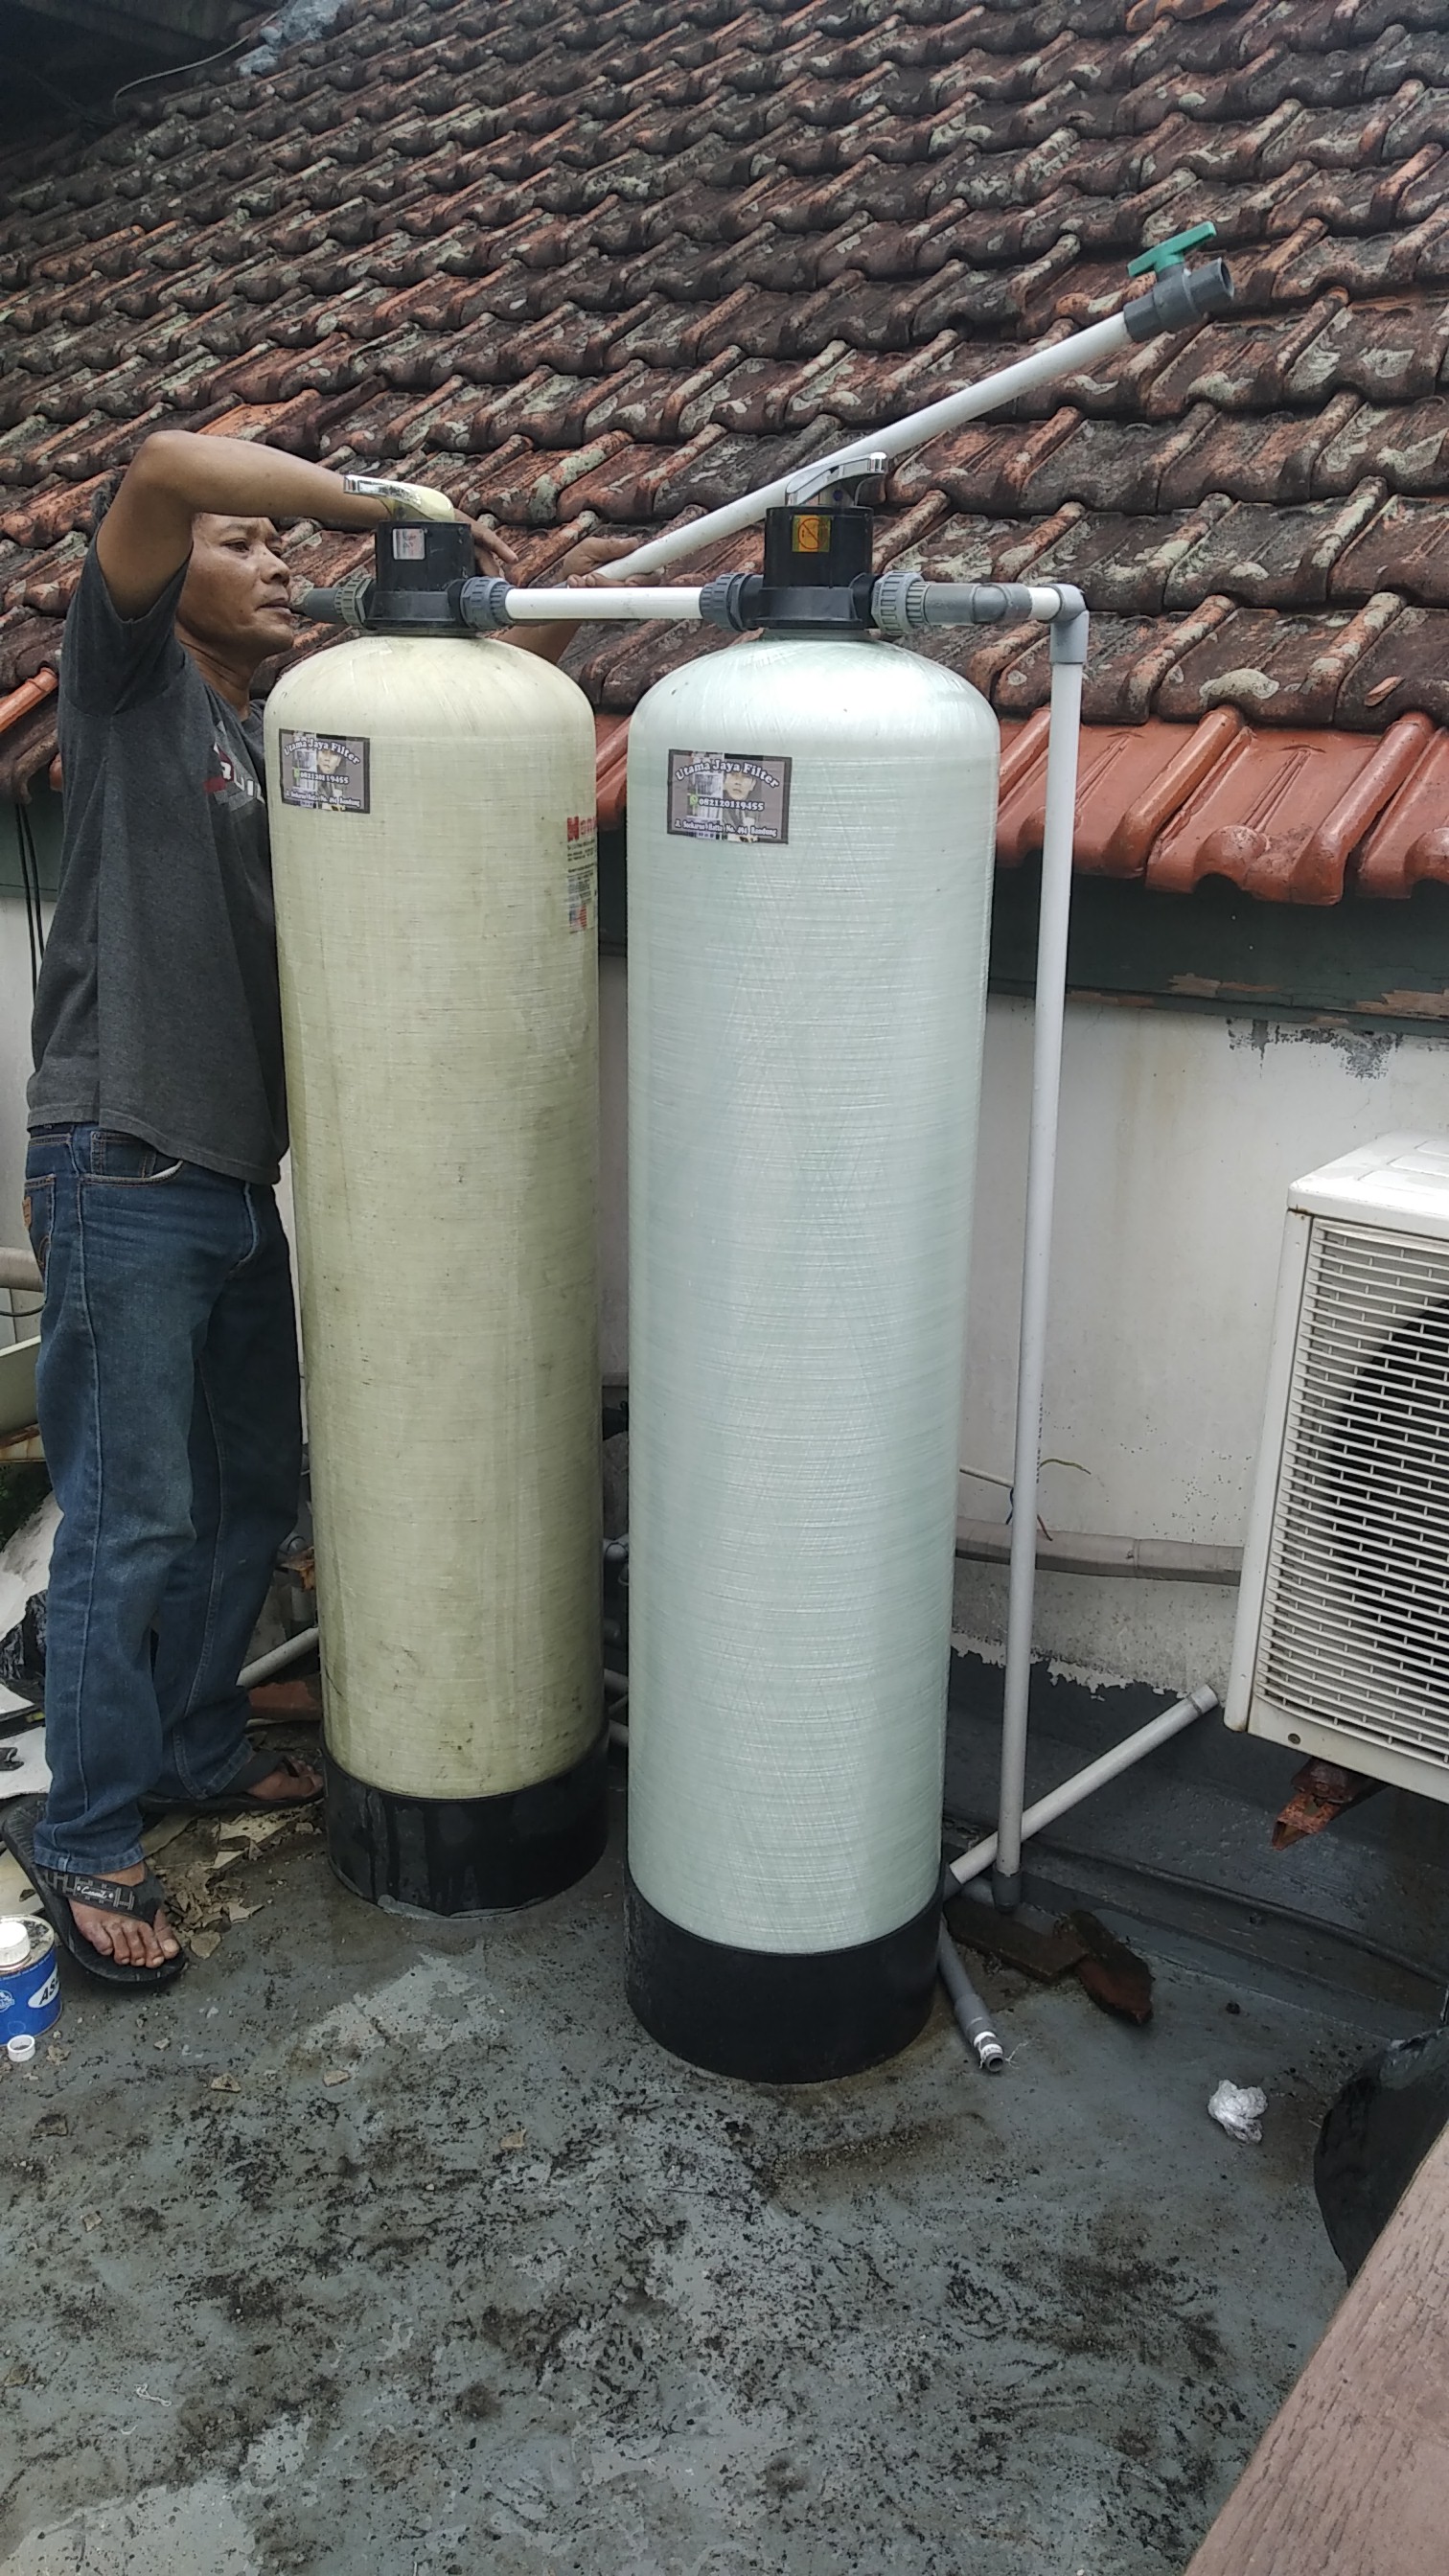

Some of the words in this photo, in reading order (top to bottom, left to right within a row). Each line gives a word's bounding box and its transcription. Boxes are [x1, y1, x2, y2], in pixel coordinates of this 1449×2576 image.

[284, 741, 307, 756] Utama
[309, 738, 329, 750] Jaya
[331, 742, 360, 765] Filter
[675, 762, 711, 780] Utama
[712, 759, 741, 772] Jaya
[742, 762, 780, 788] Filter
[698, 797, 765, 812] 082120119455
